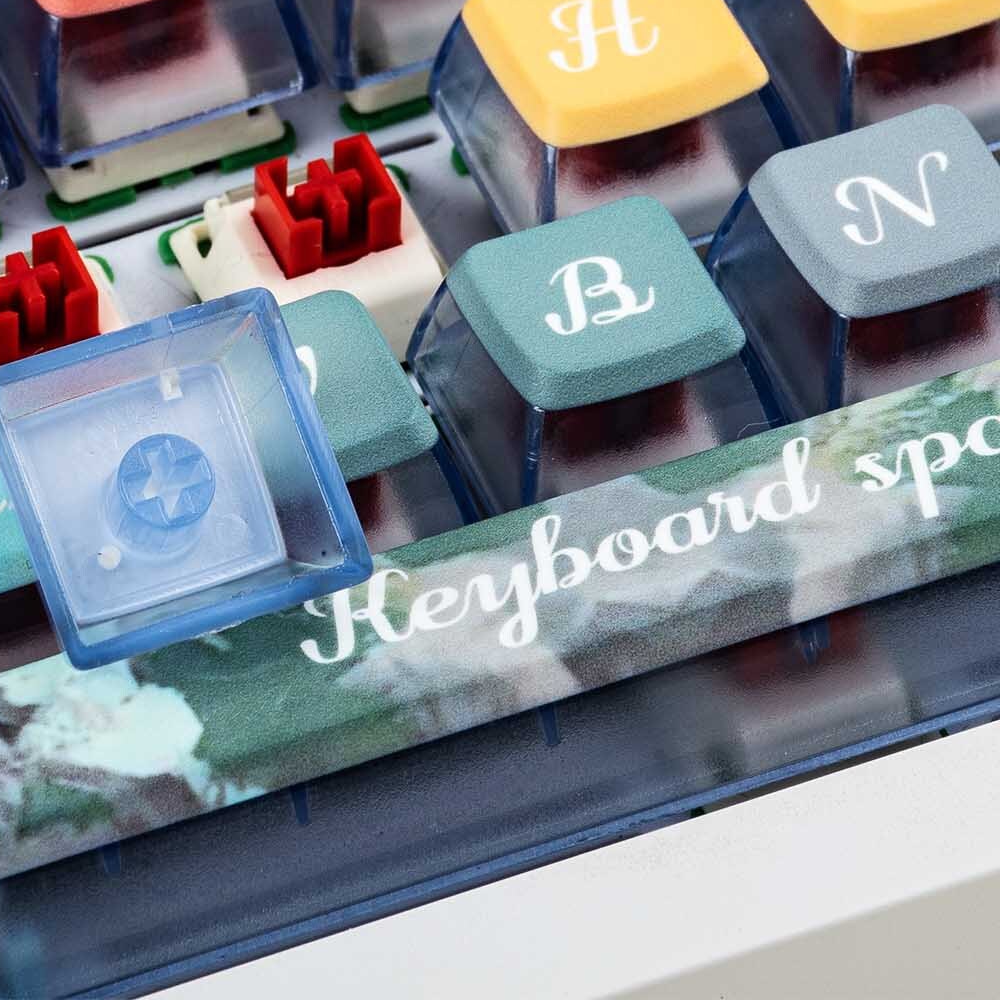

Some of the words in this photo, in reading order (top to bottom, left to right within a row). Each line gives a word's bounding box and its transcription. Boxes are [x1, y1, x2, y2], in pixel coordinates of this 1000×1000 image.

[834, 151, 948, 246] N
[543, 256, 655, 336] B
[299, 436, 821, 664] Keyboard
